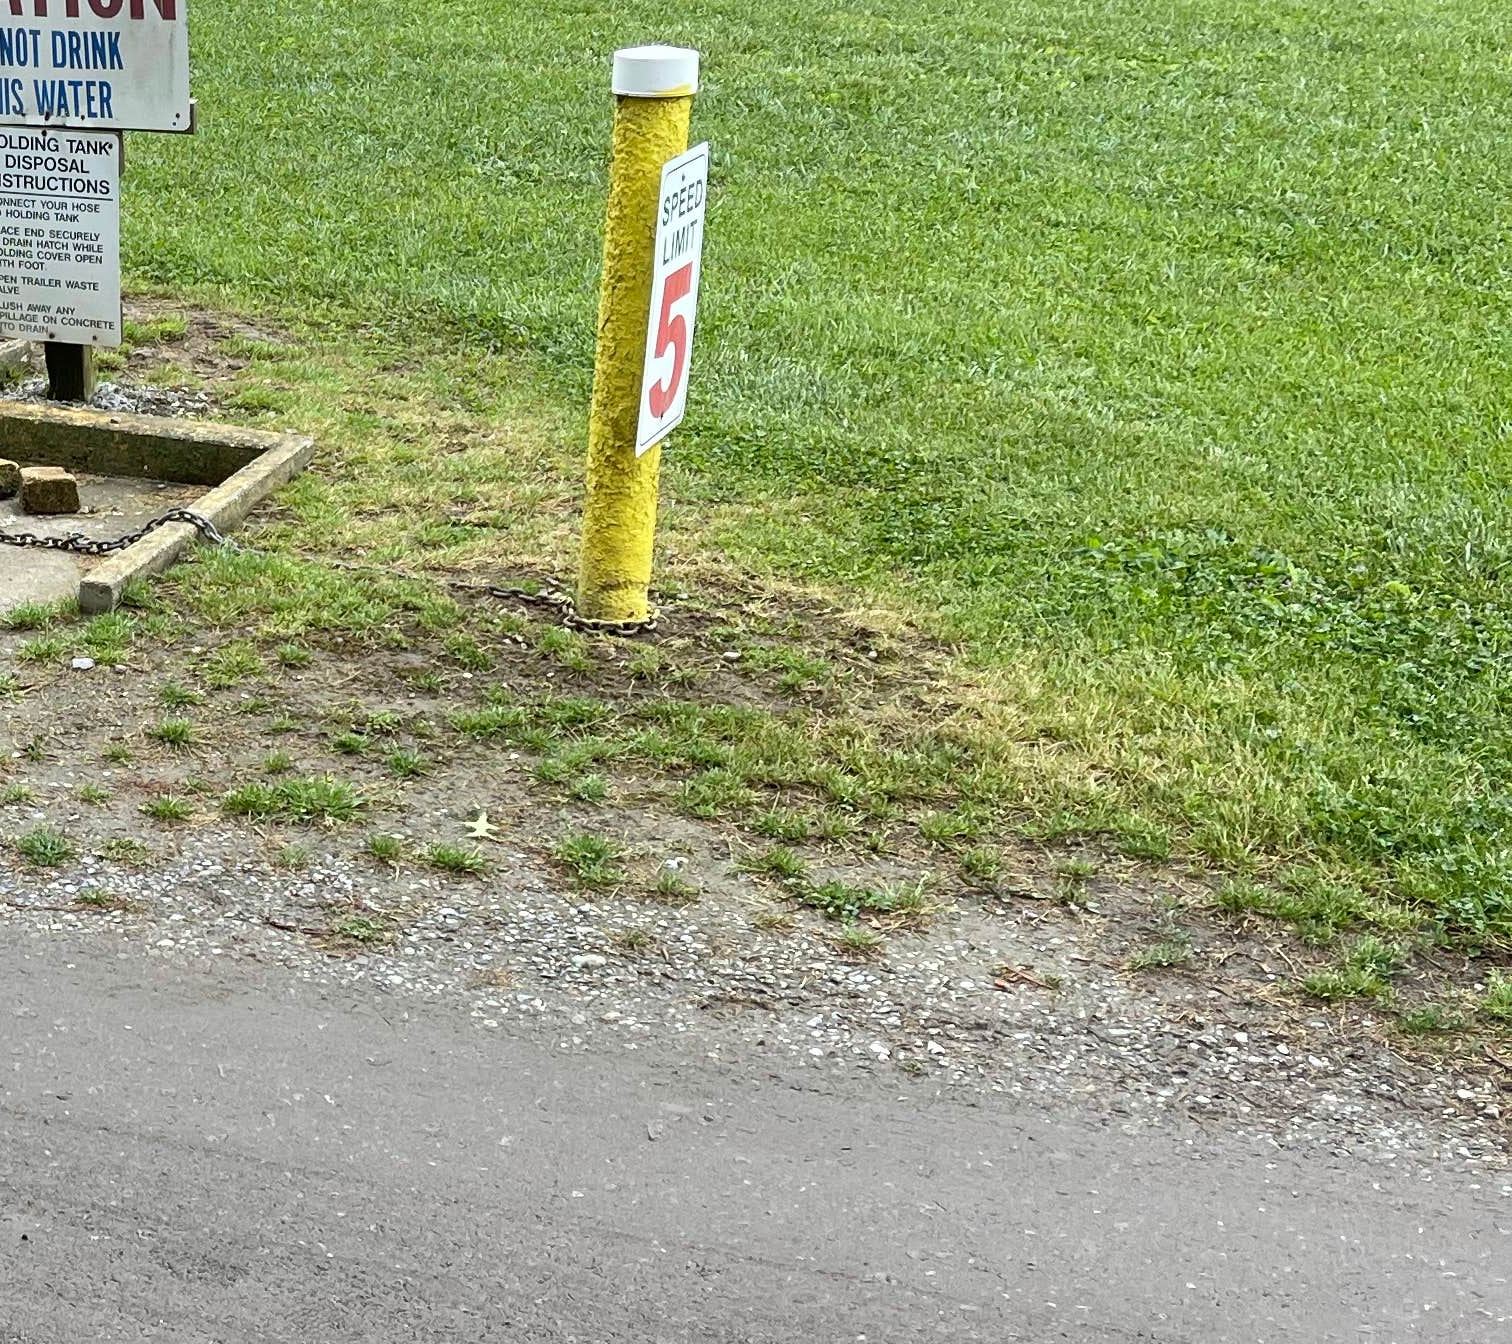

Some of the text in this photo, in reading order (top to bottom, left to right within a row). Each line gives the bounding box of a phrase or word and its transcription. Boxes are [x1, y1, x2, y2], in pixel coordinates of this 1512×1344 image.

[0, 27, 41, 68] NOT
[51, 30, 124, 70] DRINK
[34, 80, 113, 119] WATER
[66, 139, 110, 155] TANK
[5, 155, 90, 174] DISPOSAL
[41, 200, 67, 210] YOUR
[72, 202, 100, 213] HOSE
[663, 179, 703, 227] SPEED
[6, 209, 50, 221] HOLDING
[55, 213, 79, 223] TANK
[24, 228, 45, 237] END
[49, 230, 100, 241] SECURELY
[3, 237, 32, 247] DRAIN
[37, 240, 69, 251] HATCH
[73, 243, 103, 253] WHILE
[663, 219, 697, 266] LIMIT
[37, 251, 71, 262] COVER
[75, 254, 103, 264] OPEN
[21, 276, 61, 288] TRAILER
[65, 280, 99, 291] WASTE
[27, 303, 51, 313] AWAY
[56, 306, 75, 315] ANY
[19, 323, 48, 334] DRAIN
[43, 316, 57, 325] ON
[61, 317, 115, 330] CONCRETE
[649, 260, 693, 418] 5
